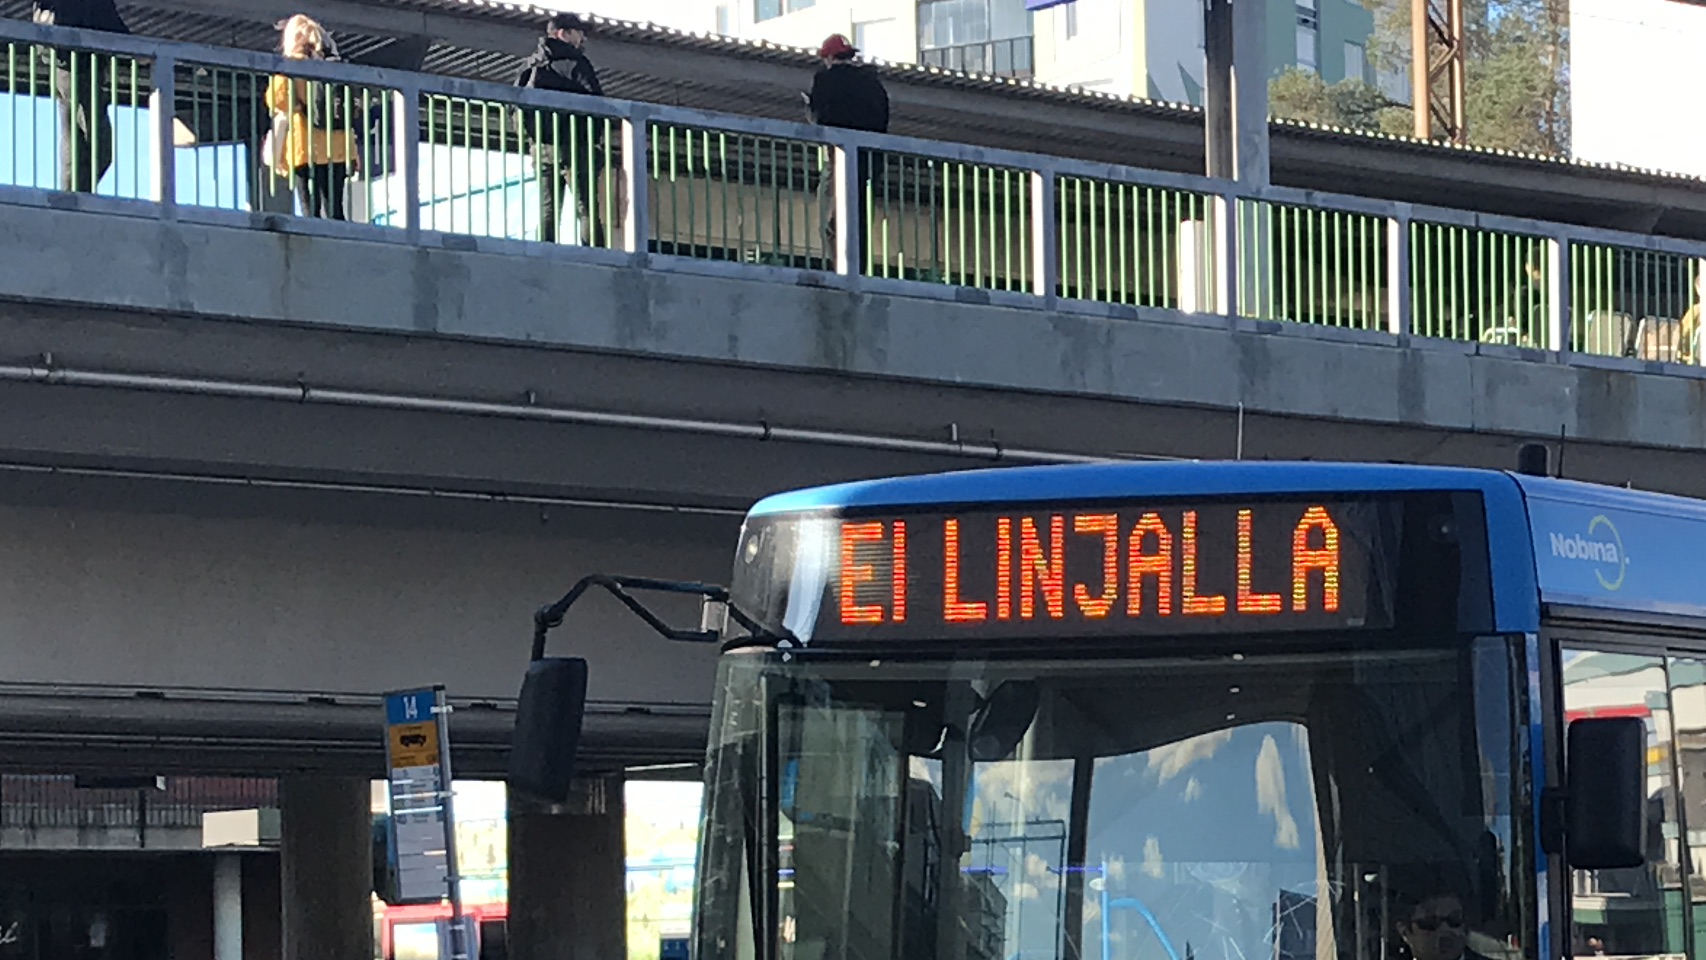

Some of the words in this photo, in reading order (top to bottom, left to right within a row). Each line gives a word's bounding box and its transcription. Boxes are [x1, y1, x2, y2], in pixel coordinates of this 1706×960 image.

[1549, 532, 1619, 563] Nobina
[841, 520, 906, 624] EI
[943, 506, 1339, 621] LINJALLA
[403, 696, 418, 719] 14
